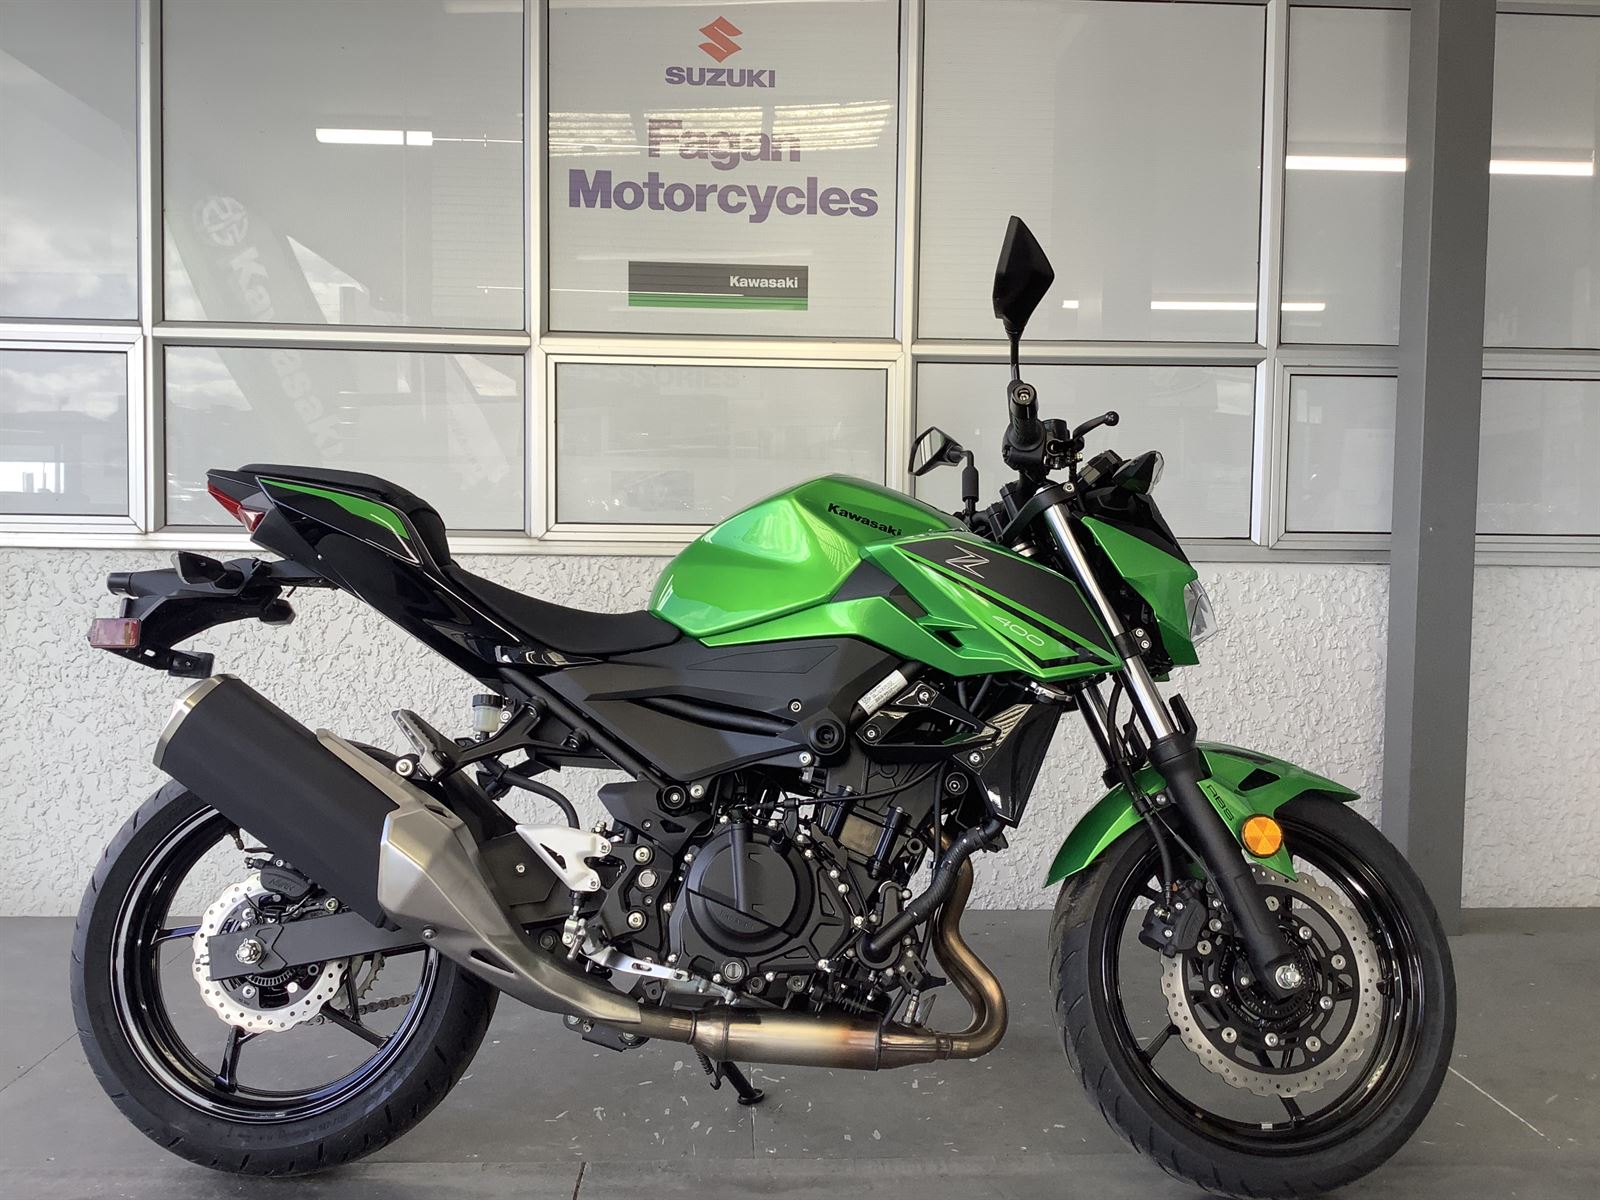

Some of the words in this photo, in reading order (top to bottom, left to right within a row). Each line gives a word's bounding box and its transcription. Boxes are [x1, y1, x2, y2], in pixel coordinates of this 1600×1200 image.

[665, 66, 776, 88] SUZUKI
[648, 119, 801, 171] Fagan
[568, 169, 879, 223] Motorcycles
[729, 275, 799, 290] Kawasaki
[827, 503, 902, 537] Kawasaki
[991, 615, 1045, 648] 400
[1206, 784, 1235, 821] ABS
